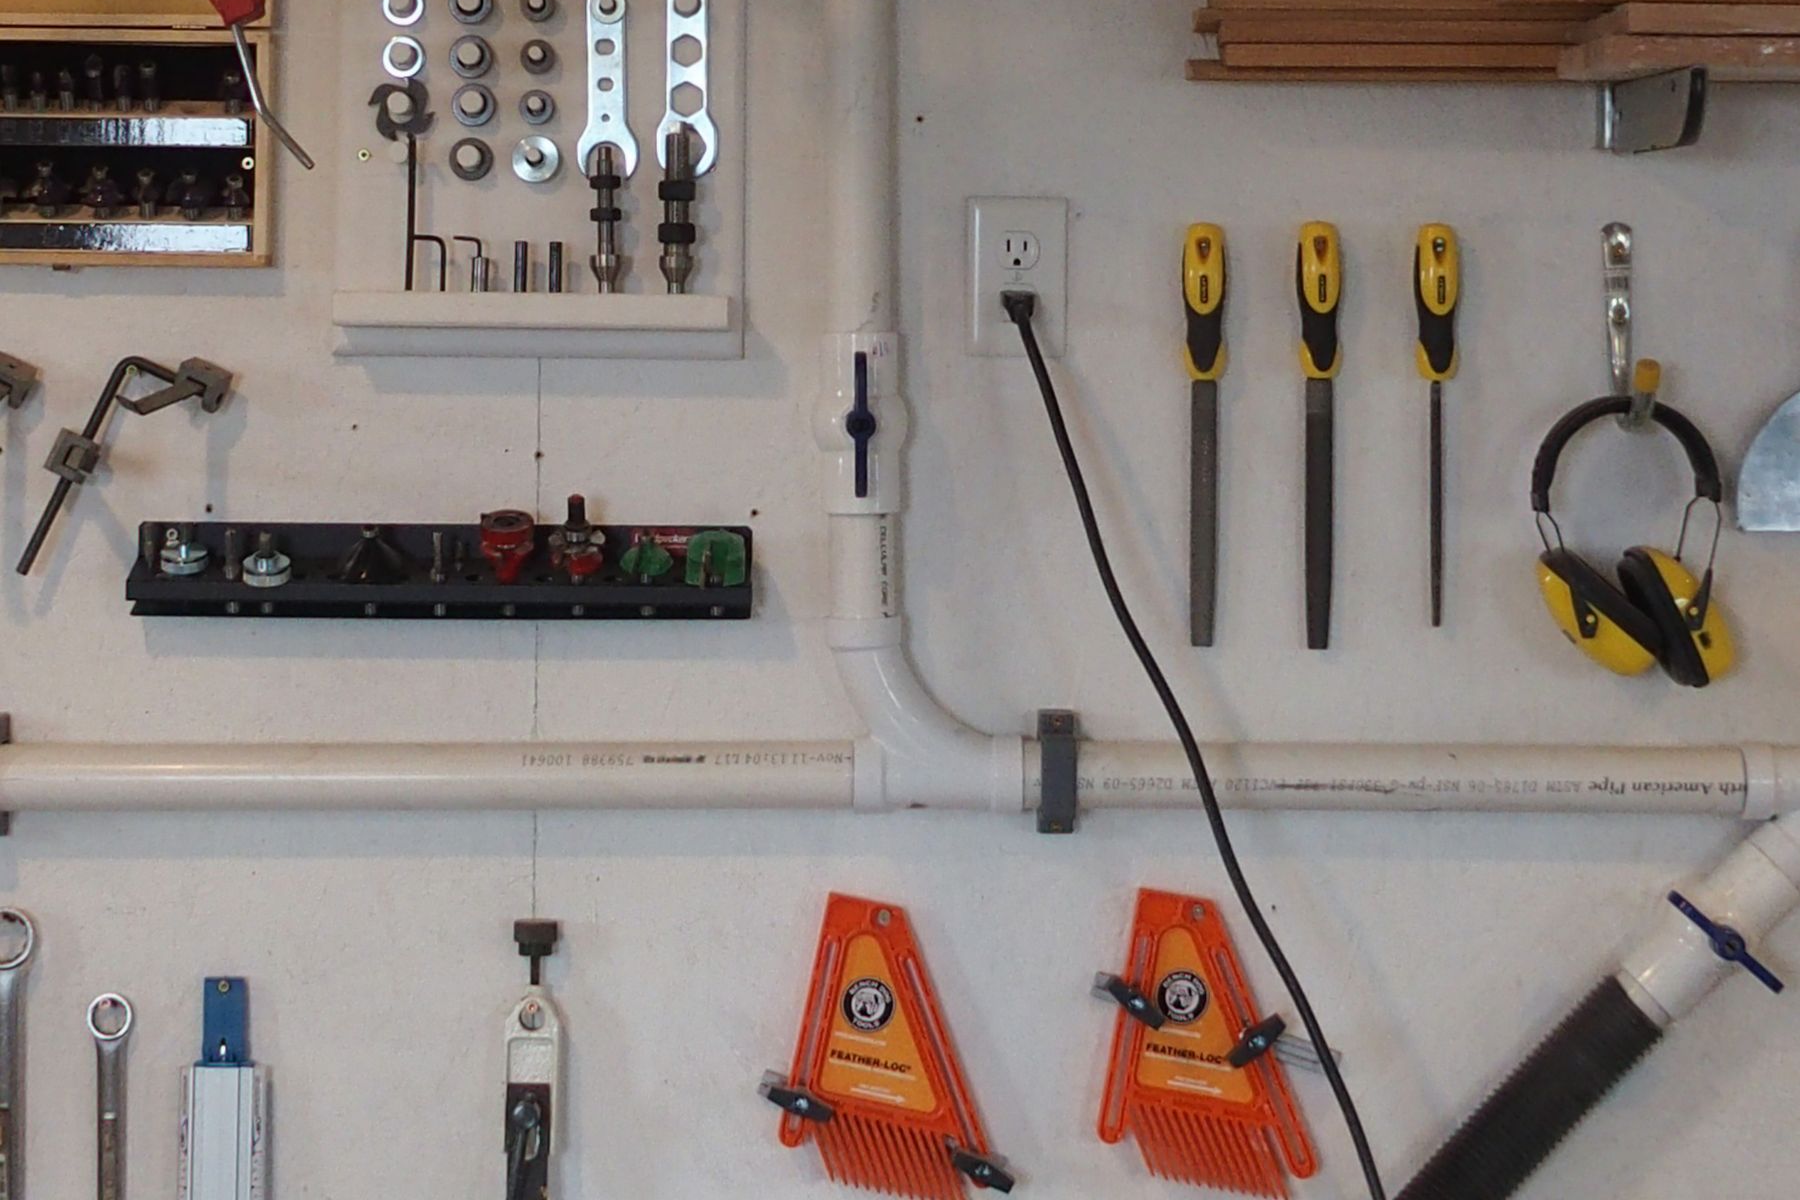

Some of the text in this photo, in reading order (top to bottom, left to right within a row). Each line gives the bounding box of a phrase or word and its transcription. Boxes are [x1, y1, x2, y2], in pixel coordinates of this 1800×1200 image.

[1546, 779, 1582, 791] ASTM
[1588, 777, 1625, 796] Pipe
[1631, 781, 1712, 796] American
[1718, 782, 1748, 796] rth
[1167, 1010, 1195, 1022] TOOLS
[851, 1017, 880, 1029] TOOLS
